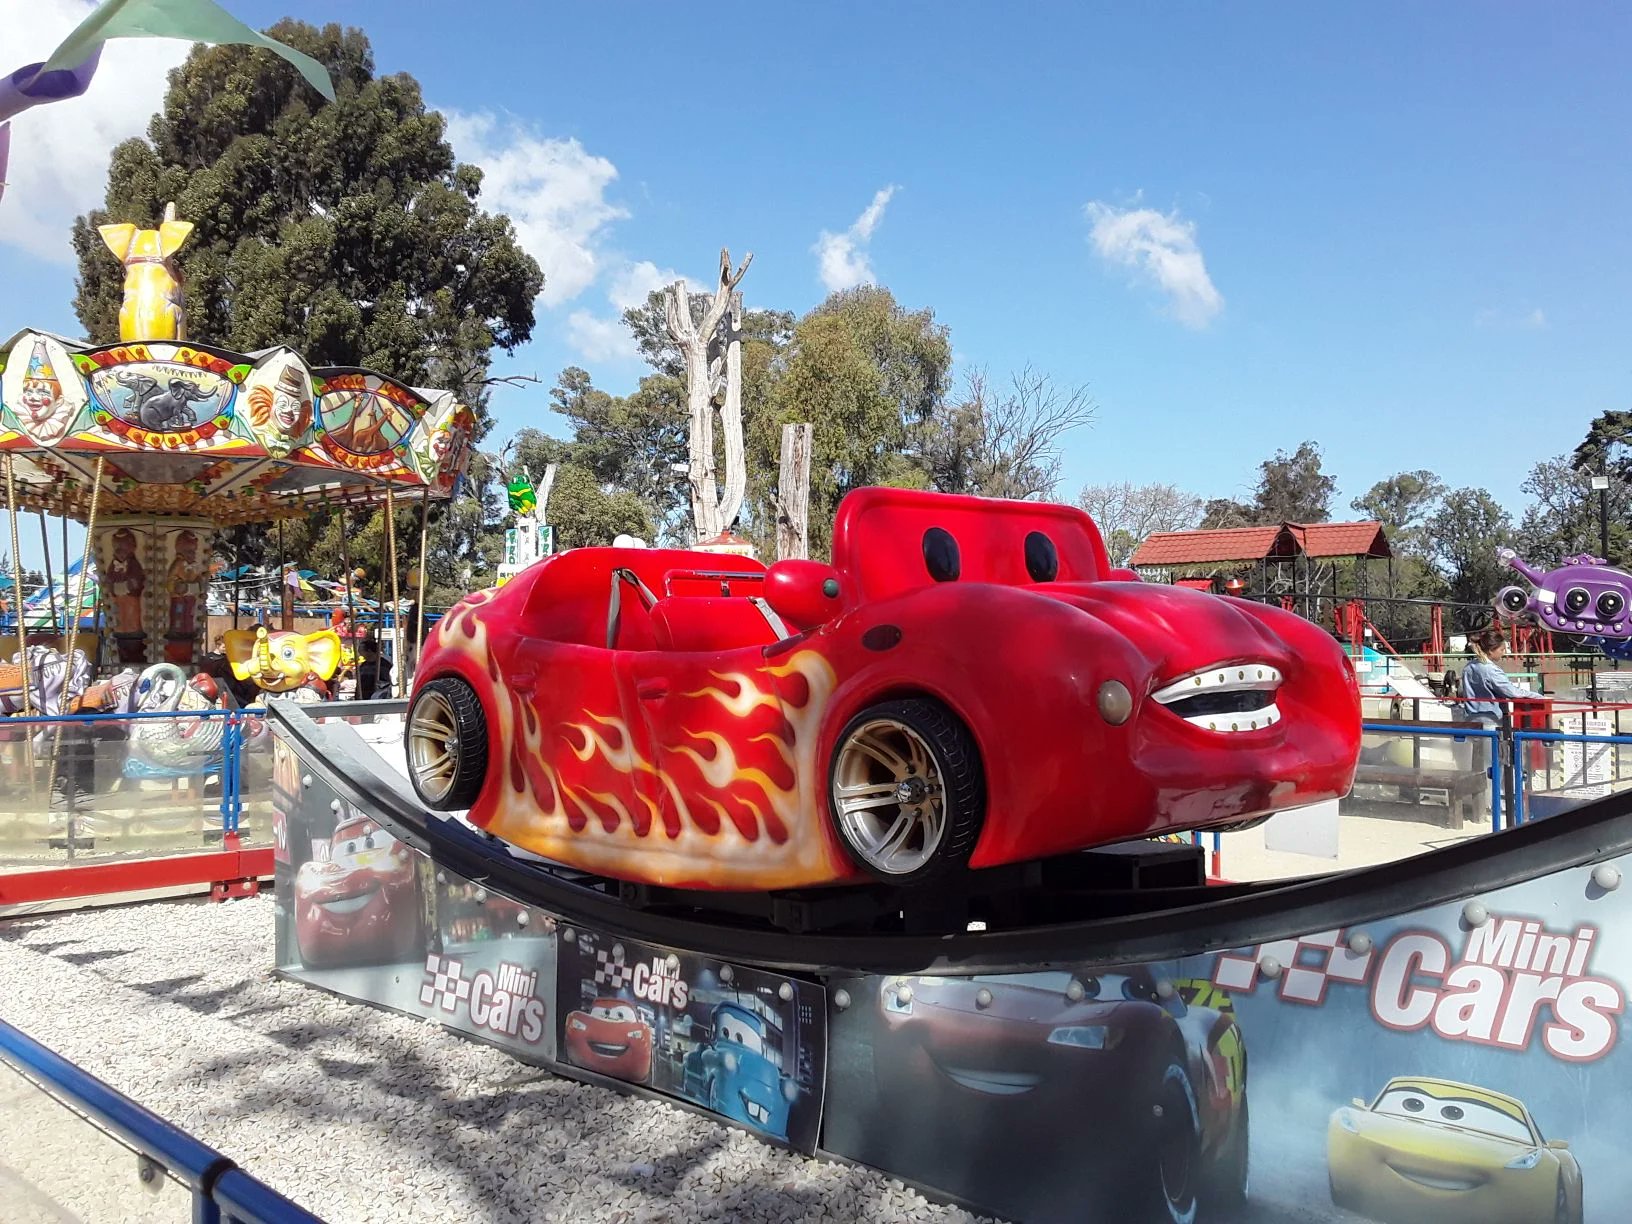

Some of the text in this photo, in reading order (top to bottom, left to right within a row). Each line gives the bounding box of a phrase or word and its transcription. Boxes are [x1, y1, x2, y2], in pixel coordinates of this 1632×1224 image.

[1465, 918, 1595, 976] Mini
[470, 973, 544, 1041] Cars
[498, 963, 537, 997] Mini
[633, 963, 688, 1009] Cars
[1375, 935, 1620, 1057] Cars
